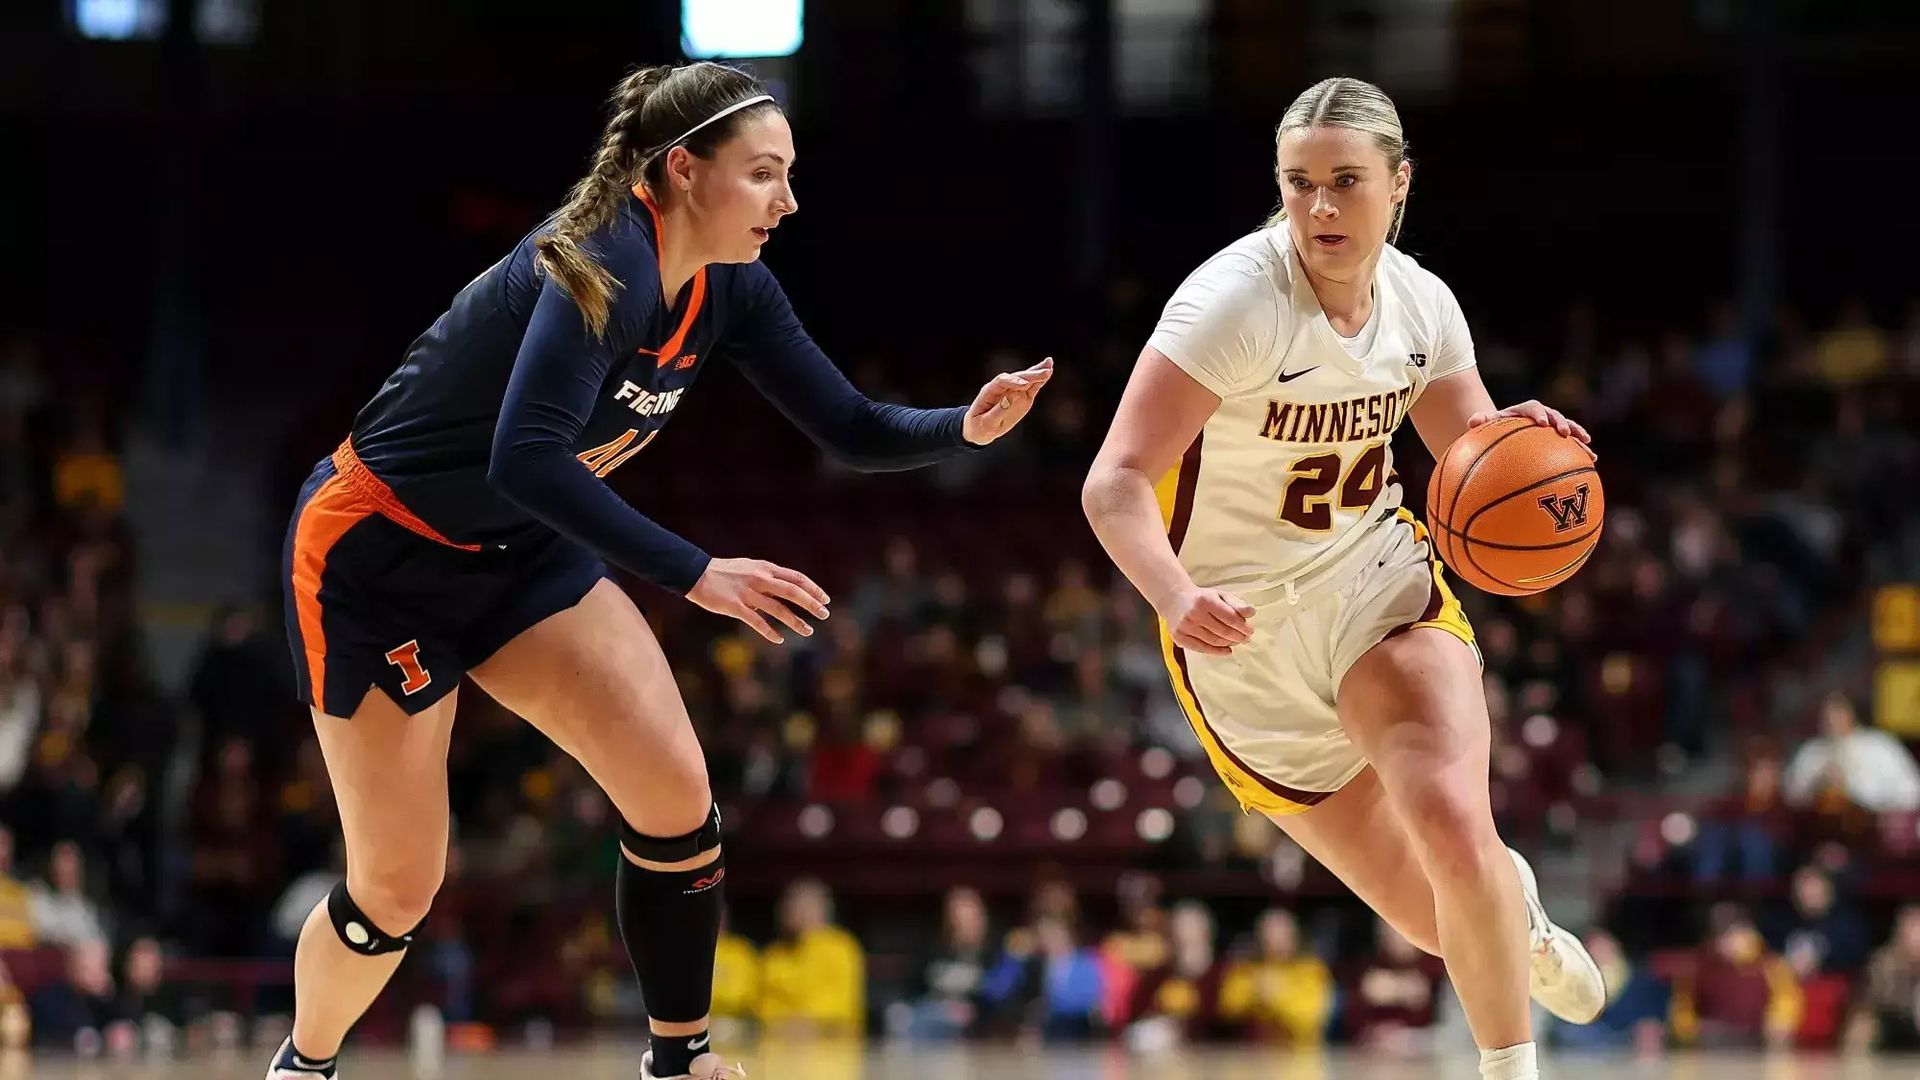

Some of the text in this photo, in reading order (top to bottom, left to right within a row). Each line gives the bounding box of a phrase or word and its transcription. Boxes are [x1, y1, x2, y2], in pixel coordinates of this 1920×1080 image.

[613, 379, 685, 418] FIGING
[1277, 442, 1386, 533] 24
[1537, 483, 1590, 533] W
[385, 638, 432, 696] I
